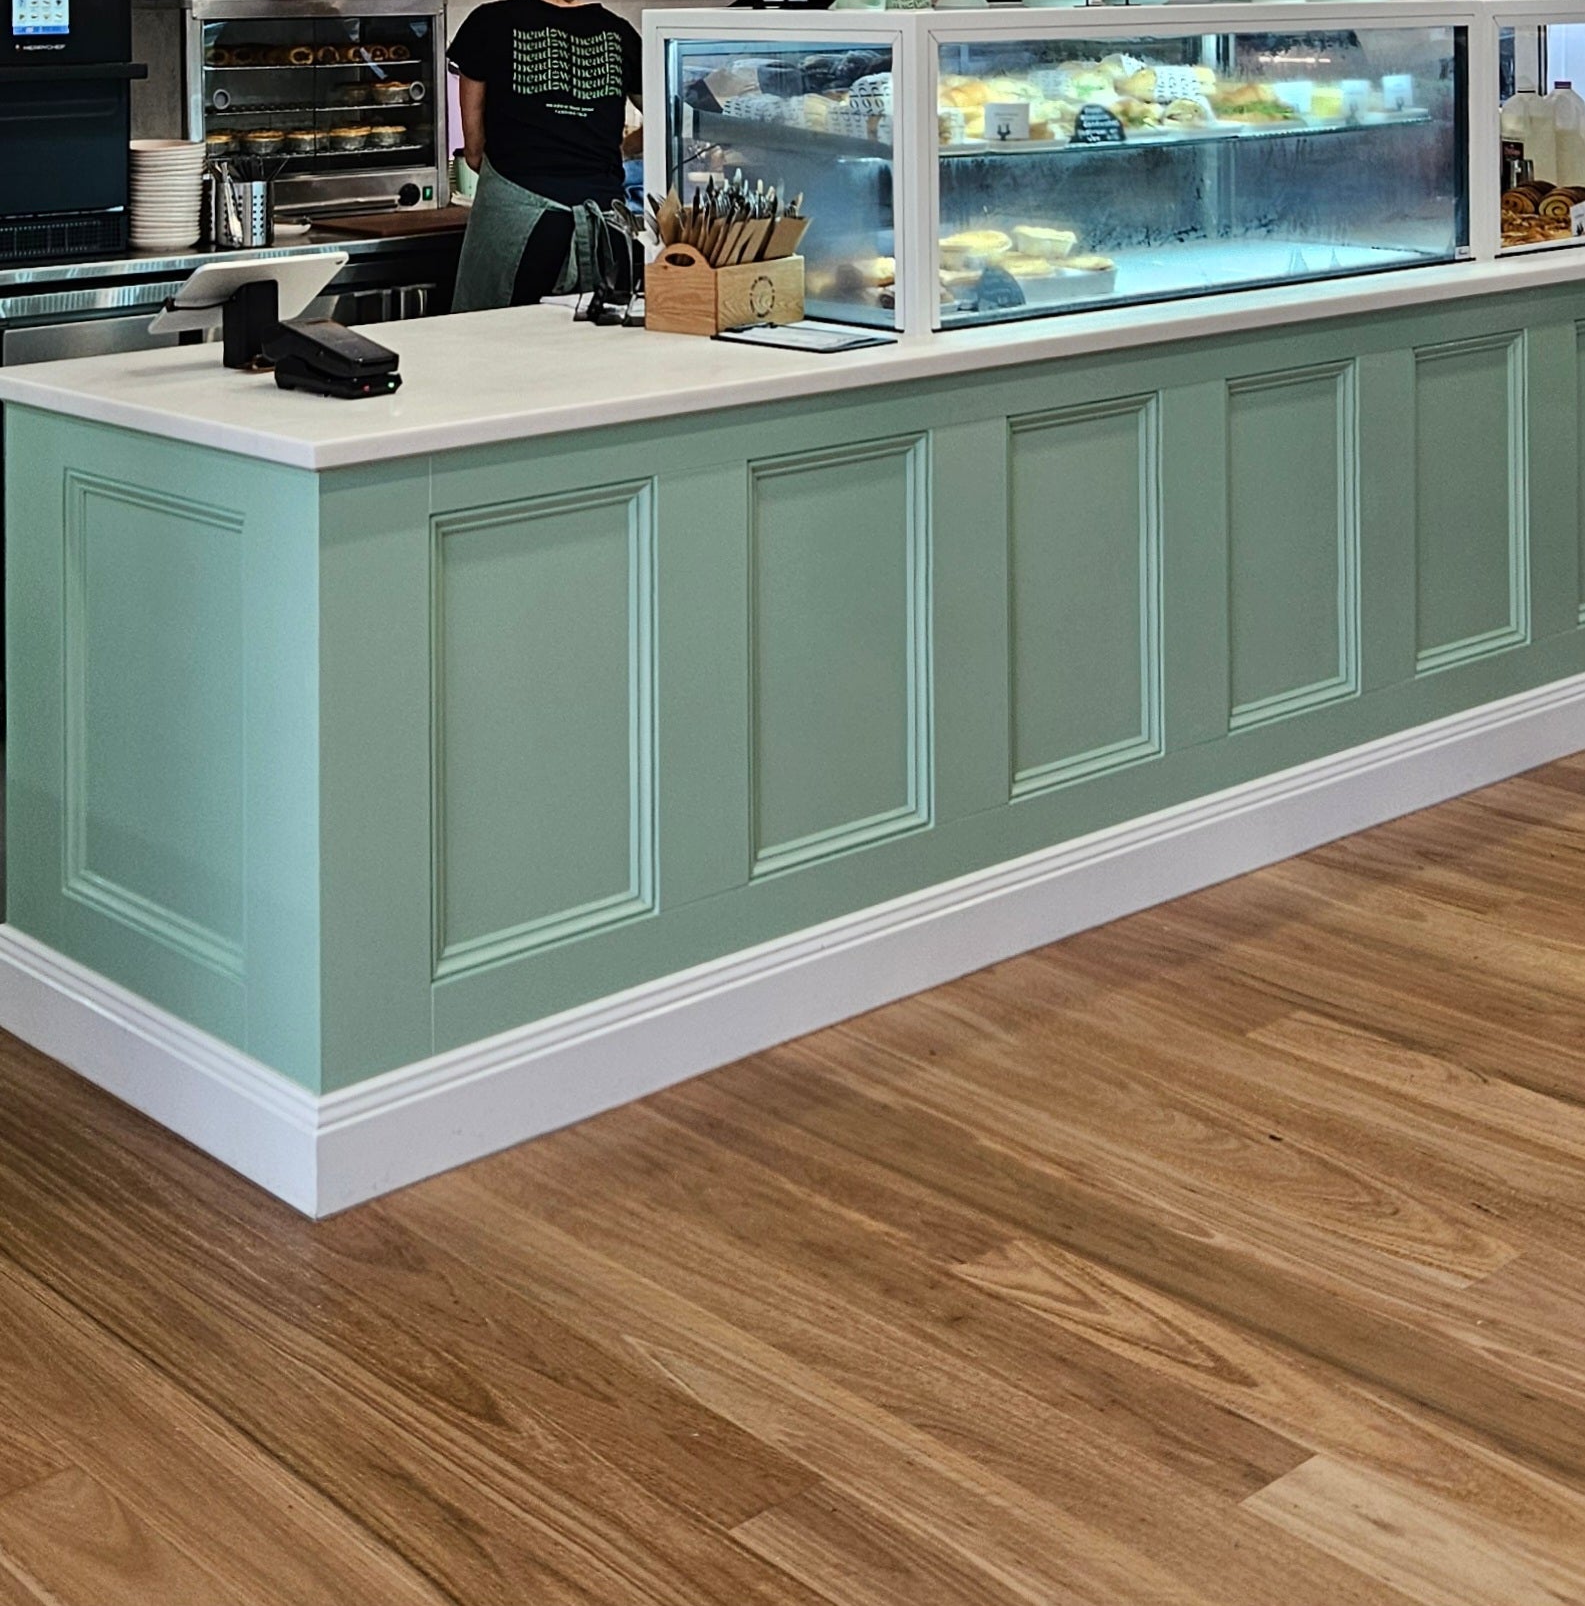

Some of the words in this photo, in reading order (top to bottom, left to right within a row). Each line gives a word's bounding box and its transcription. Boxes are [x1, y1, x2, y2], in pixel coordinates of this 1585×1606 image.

[513, 27, 568, 40] meadow
[513, 37, 569, 51] meadow
[513, 47, 569, 62] meadow
[513, 58, 569, 72] meadow
[513, 69, 569, 83] meadow
[513, 80, 570, 94] meadow
